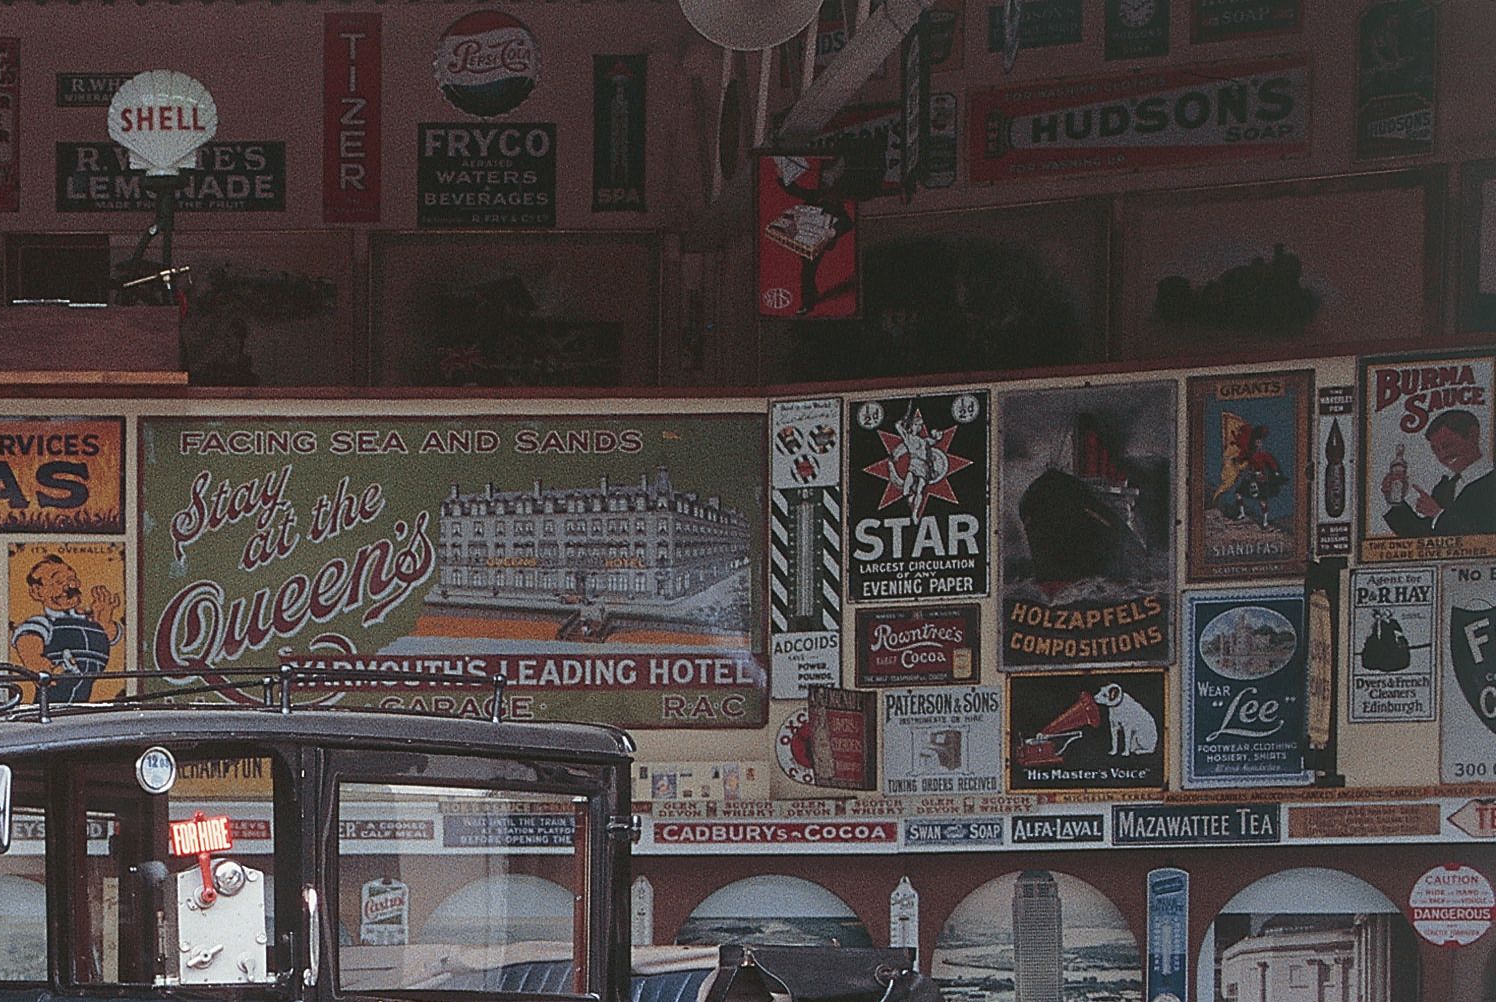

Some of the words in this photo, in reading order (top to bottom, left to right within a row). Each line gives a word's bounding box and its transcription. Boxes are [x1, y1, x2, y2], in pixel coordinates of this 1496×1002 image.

[1220, 8, 1271, 25] SOAP
[122, 106, 205, 131] SHELL
[340, 34, 366, 190] TIZER
[1031, 77, 1293, 143] HUDSON'S
[1224, 124, 1292, 142] SOAP
[424, 129, 550, 157] FRYCO
[67, 175, 274, 199] LEMNADE
[436, 171, 537, 184] WATERS
[424, 193, 548, 206] BEVERAGES
[1219, 381, 1281, 396] GRANTS
[1375, 367, 1474, 413] BURMA
[1401, 386, 1484, 433] SAUCE
[181, 431, 318, 454] FACING
[330, 431, 407, 453] SEA
[420, 431, 500, 453] AND
[515, 430, 643, 453] SANDS
[172, 465, 292, 564] Stay
[240, 508, 300, 572] at
[305, 476, 384, 543] the
[854, 514, 979, 561] STAR
[1418, 538, 1463, 547] SAUCE
[860, 563, 904, 574] LARGEST
[909, 560, 974, 569] CIRCULATION
[863, 579, 922, 596] EVENING
[930, 578, 973, 592] PAPER
[1367, 575, 1402, 584] Agent
[1406, 575, 1421, 583] for
[154, 512, 435, 690] Queen's
[1395, 585, 1431, 603] HAY
[1011, 597, 1162, 630] HOLZAPFELS
[774, 635, 838, 654] ADCOIDS
[871, 624, 963, 651] Rowntree's
[1010, 626, 1163, 658] COMPOSITIONS
[901, 650, 946, 668] Cocoa
[505, 658, 636, 685] LEADING
[649, 657, 753, 685] HOTEL
[1198, 681, 1231, 697] WEAR
[1369, 689, 1416, 699] Cleaners
[885, 692, 952, 723] PATERSON
[963, 692, 998, 713] SONS
[1051, 767, 1107, 780] Master's
[1455, 763, 1486, 777] 300
[888, 779, 918, 793] TUNING
[922, 778, 953, 792] ORDERS
[958, 777, 997, 791] RECEIVED
[910, 825, 942, 839] SWAN
[969, 823, 1000, 839] SOAP
[1013, 818, 1103, 841] ALFA-LAVAL
[1120, 809, 1230, 838] MAZAWATTEE
[1236, 808, 1275, 837] TEA
[172, 822, 199, 857] FOR
[197, 818, 231, 851] HIRE
[804, 824, 887, 842] COCOA
[1426, 875, 1478, 884] CAUTION
[1414, 909, 1491, 919] DANGEROUS
